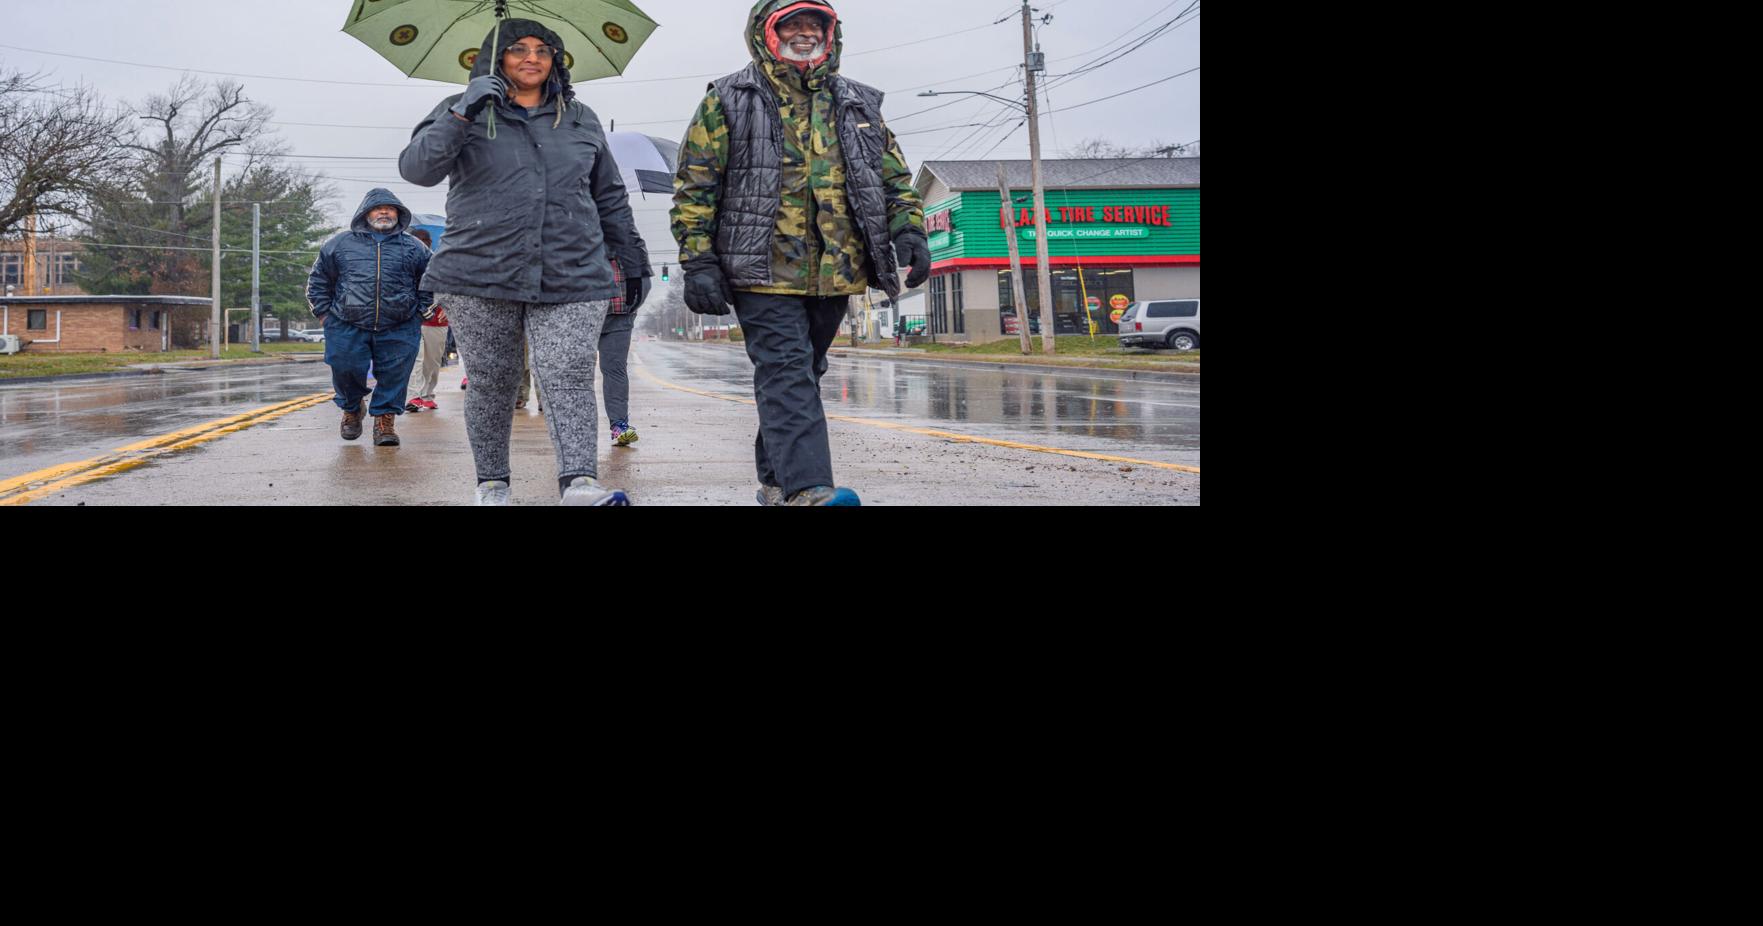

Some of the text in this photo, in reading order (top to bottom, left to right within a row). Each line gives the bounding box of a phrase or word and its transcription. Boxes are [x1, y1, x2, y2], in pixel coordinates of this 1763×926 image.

[1058, 206, 1095, 223] TIRE
[1103, 205, 1172, 227] SERVICE
[1047, 229, 1073, 238] QUICK
[1076, 229, 1111, 237] CHANGE
[1114, 228, 1143, 237] ARTIST
